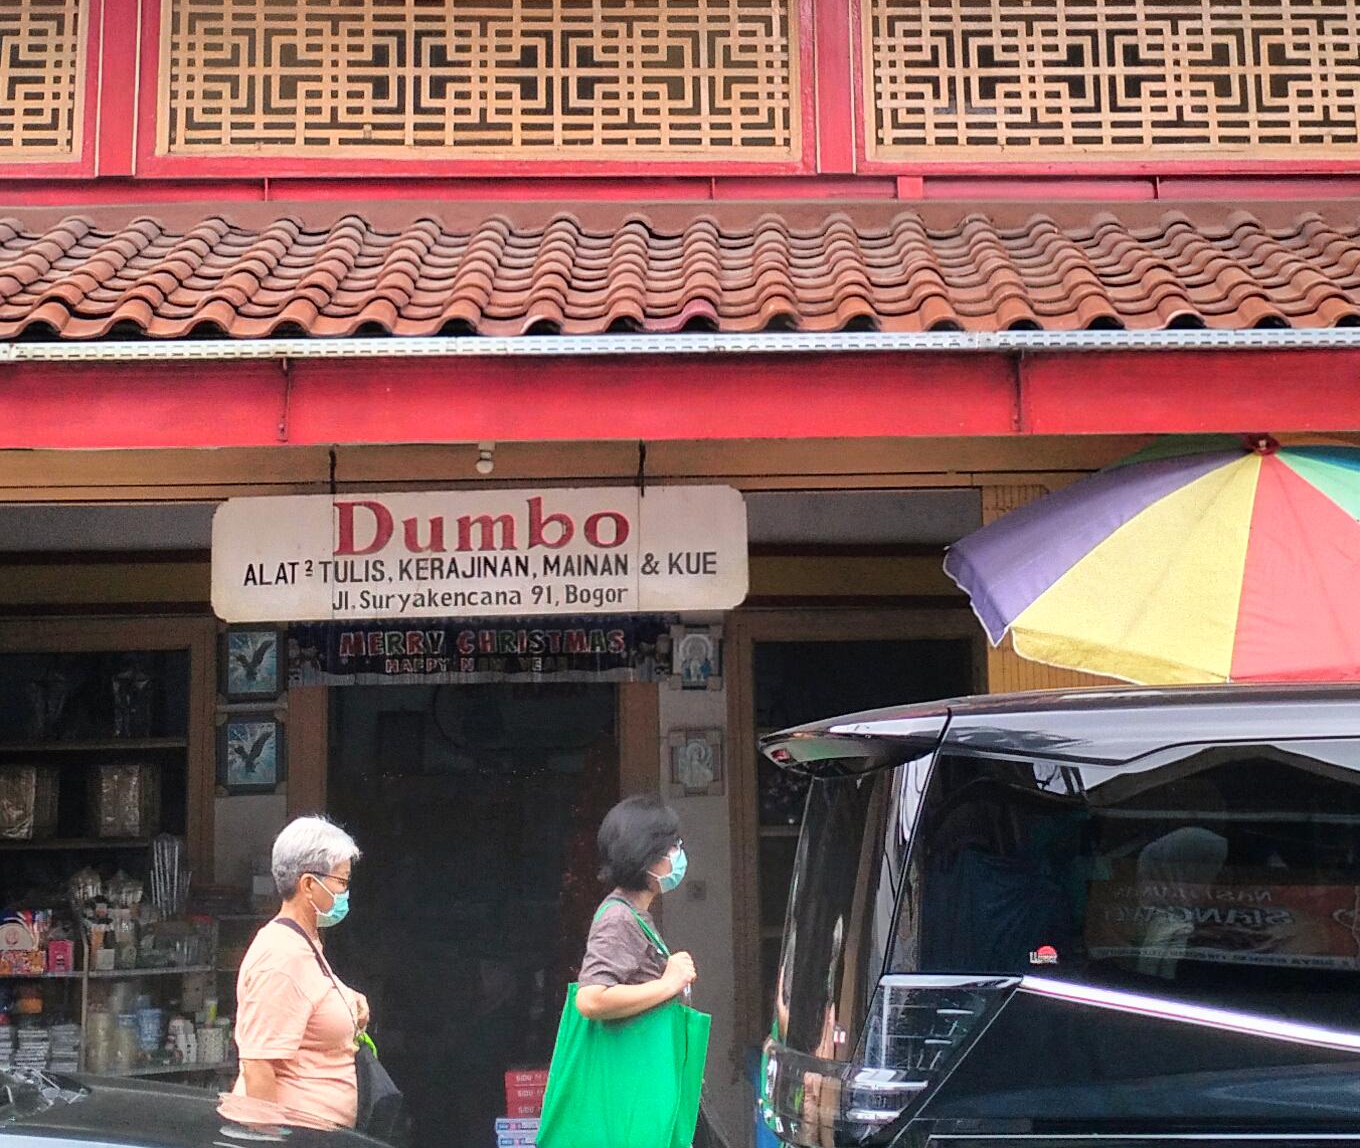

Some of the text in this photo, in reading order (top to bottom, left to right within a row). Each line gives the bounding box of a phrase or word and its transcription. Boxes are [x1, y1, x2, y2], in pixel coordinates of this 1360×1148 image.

[332, 495, 631, 557] Dumbo
[318, 559, 393, 585] TULIS,
[398, 555, 538, 582] KERAJINAN,
[543, 553, 629, 578] MAINAN
[641, 552, 660, 575] &
[668, 551, 717, 575] KUE
[359, 587, 522, 613] Suryakencana
[531, 584, 560, 607] 91,
[564, 584, 629, 608] Bogor
[339, 629, 626, 656] MERRY CHRISTMAS
[385, 657, 449, 673] HAPPY
